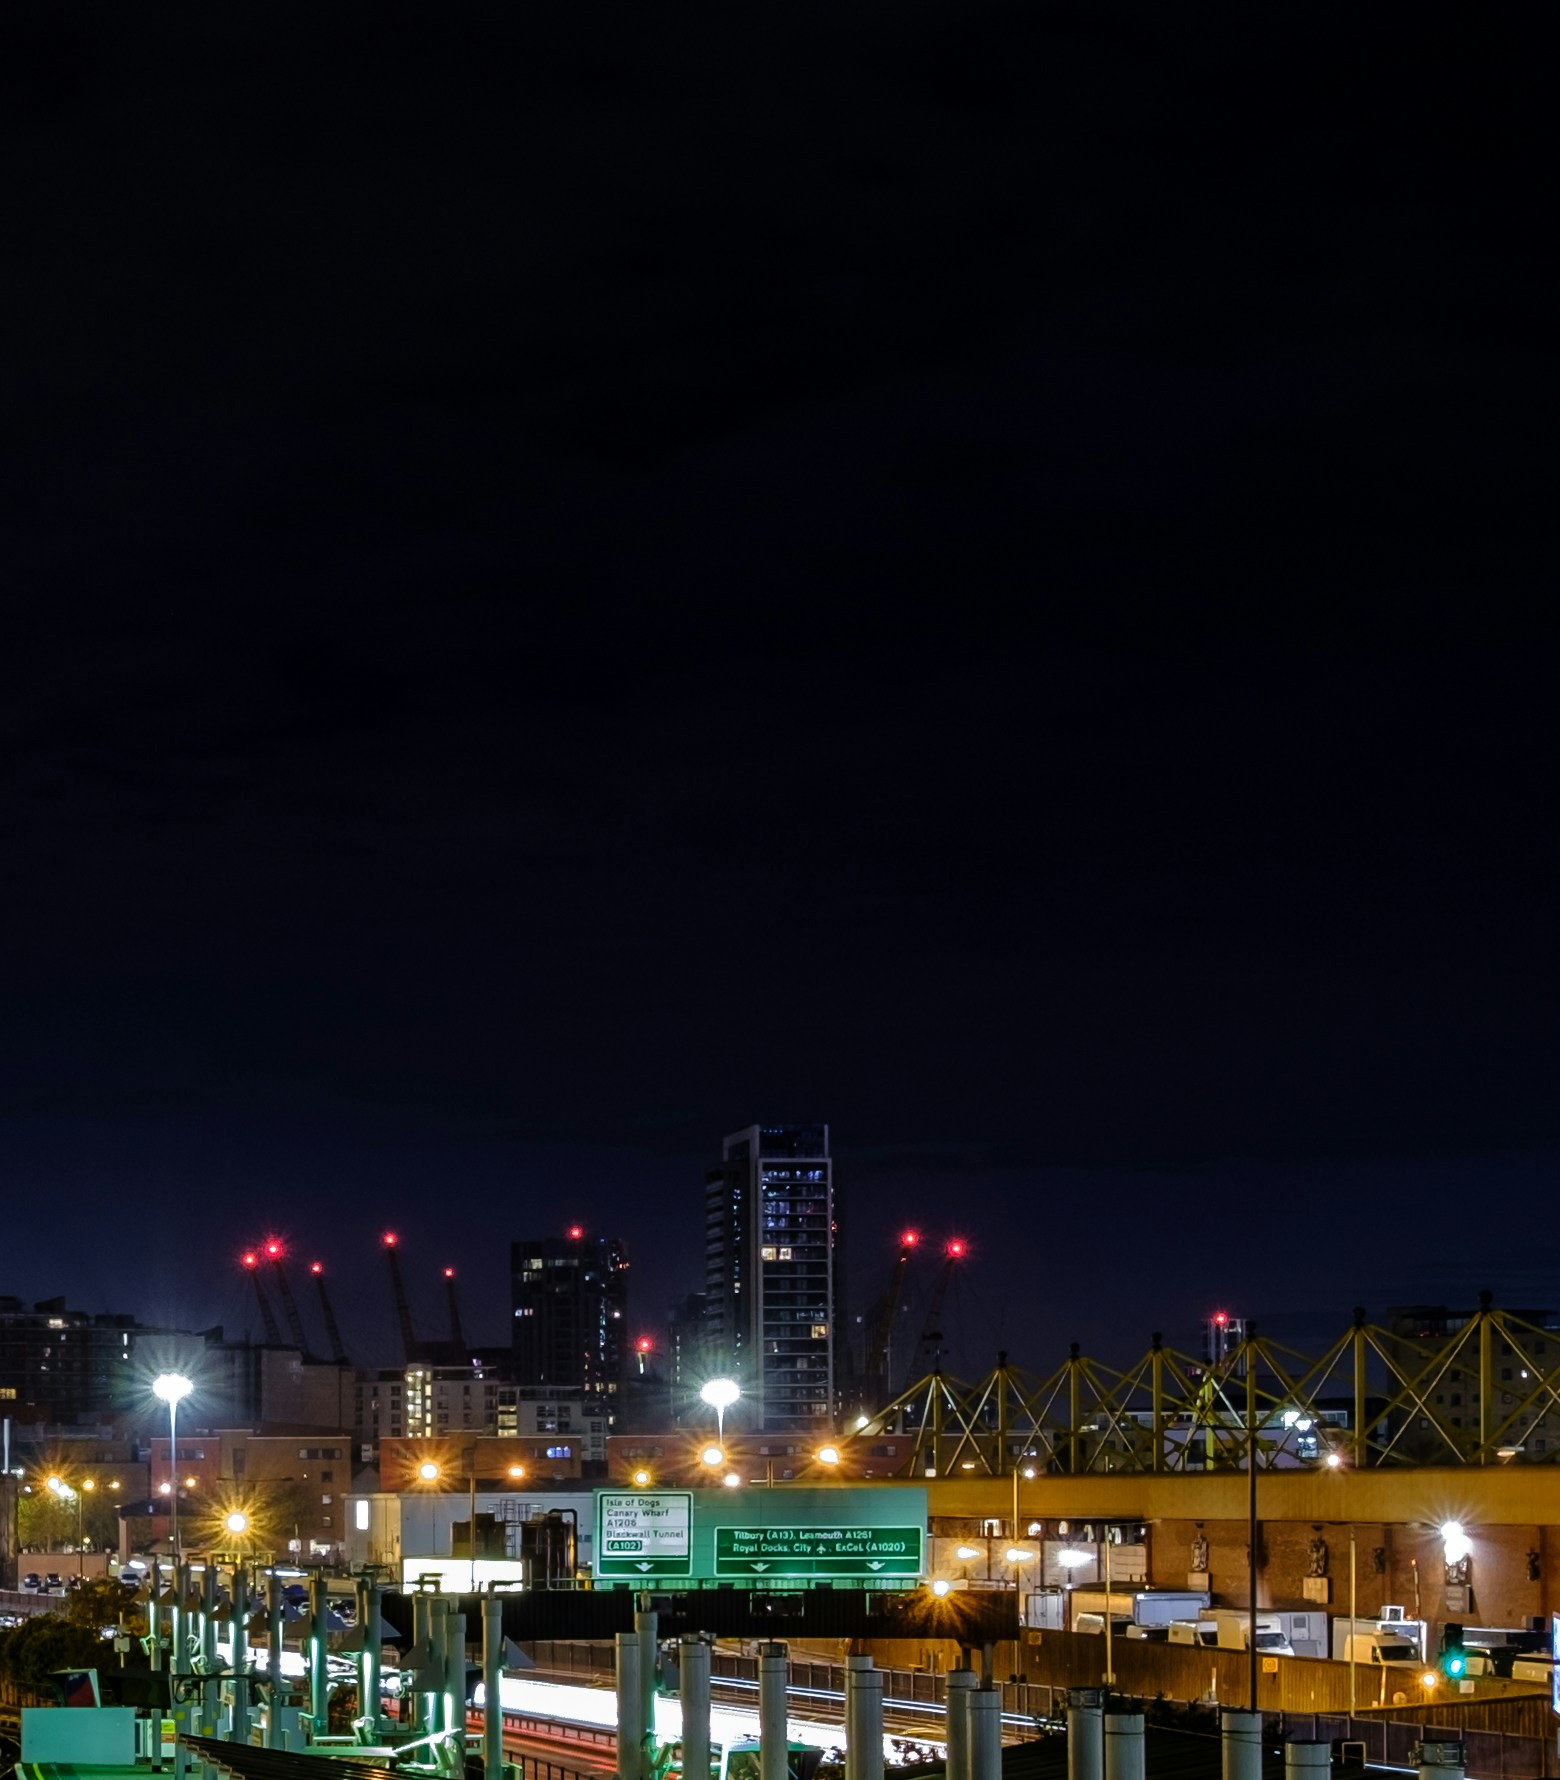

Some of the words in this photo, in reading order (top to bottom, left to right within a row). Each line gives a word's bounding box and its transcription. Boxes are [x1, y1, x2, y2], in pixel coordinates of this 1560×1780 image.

[606, 1499, 622, 1507] Isle
[625, 1499, 635, 1507] of
[638, 1499, 661, 1509] Dogs
[606, 1509, 639, 1518] Canary
[642, 1508, 670, 1517] Wharf
[606, 1529, 650, 1538] Blackwall
[653, 1529, 684, 1538] Tunnel
[733, 1530, 764, 1541] Tilbury
[799, 1530, 843, 1540] Leamouth
[608, 1540, 642, 1551] (A102)
[732, 1543, 759, 1554] Royal
[792, 1543, 812, 1554] City
[865, 1541, 906, 1553] (A1020)
